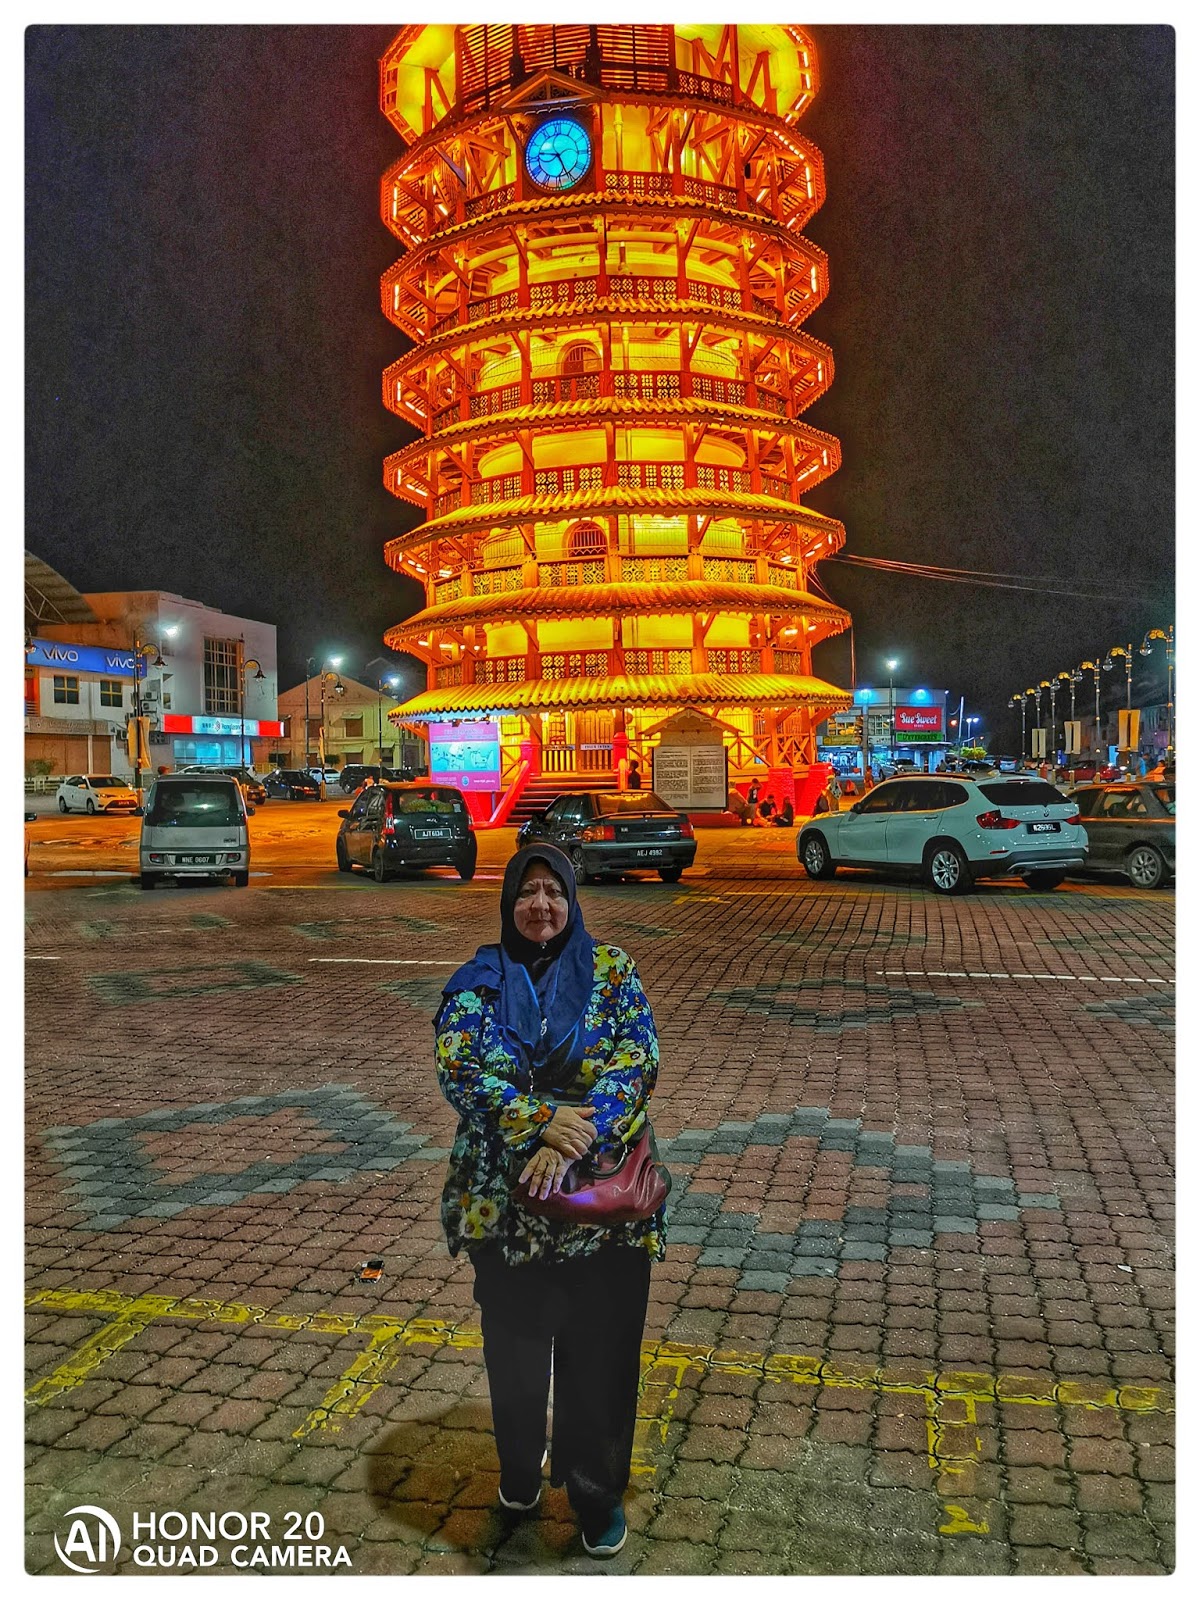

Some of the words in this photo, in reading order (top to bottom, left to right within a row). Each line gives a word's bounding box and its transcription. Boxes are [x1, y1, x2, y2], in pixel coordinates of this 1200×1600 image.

[43, 645, 79, 662] vivo
[900, 712, 915, 724] Sue
[915, 712, 937, 725] Sweet
